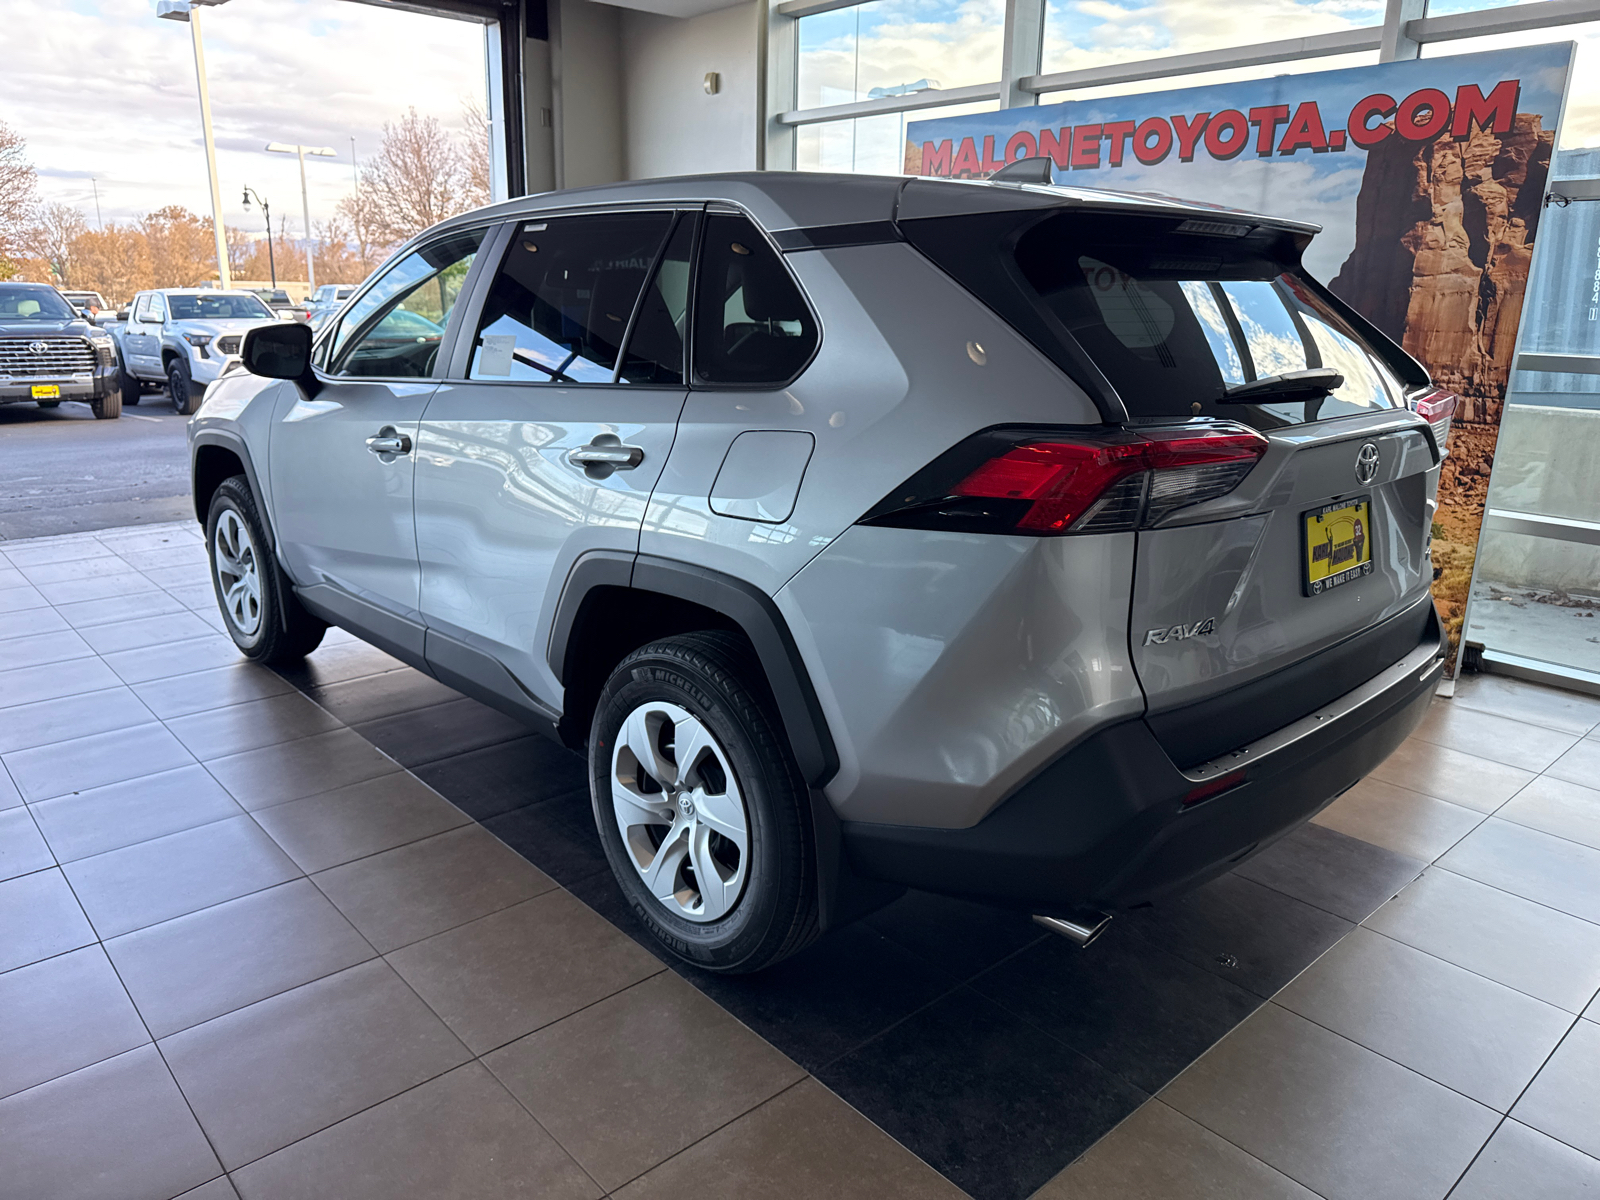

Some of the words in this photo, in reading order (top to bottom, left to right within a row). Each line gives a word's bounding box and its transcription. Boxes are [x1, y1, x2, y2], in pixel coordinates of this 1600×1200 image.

[921, 80, 1521, 177] MALONETOYOTA.COM
[1355, 525, 1362, 536] 32
[1325, 578, 1333, 589] WE
[1333, 573, 1346, 586] MAKE
[1142, 616, 1215, 647] RAV4
[654, 669, 712, 711] MICHELIN
[634, 903, 689, 953] MICHELIN
